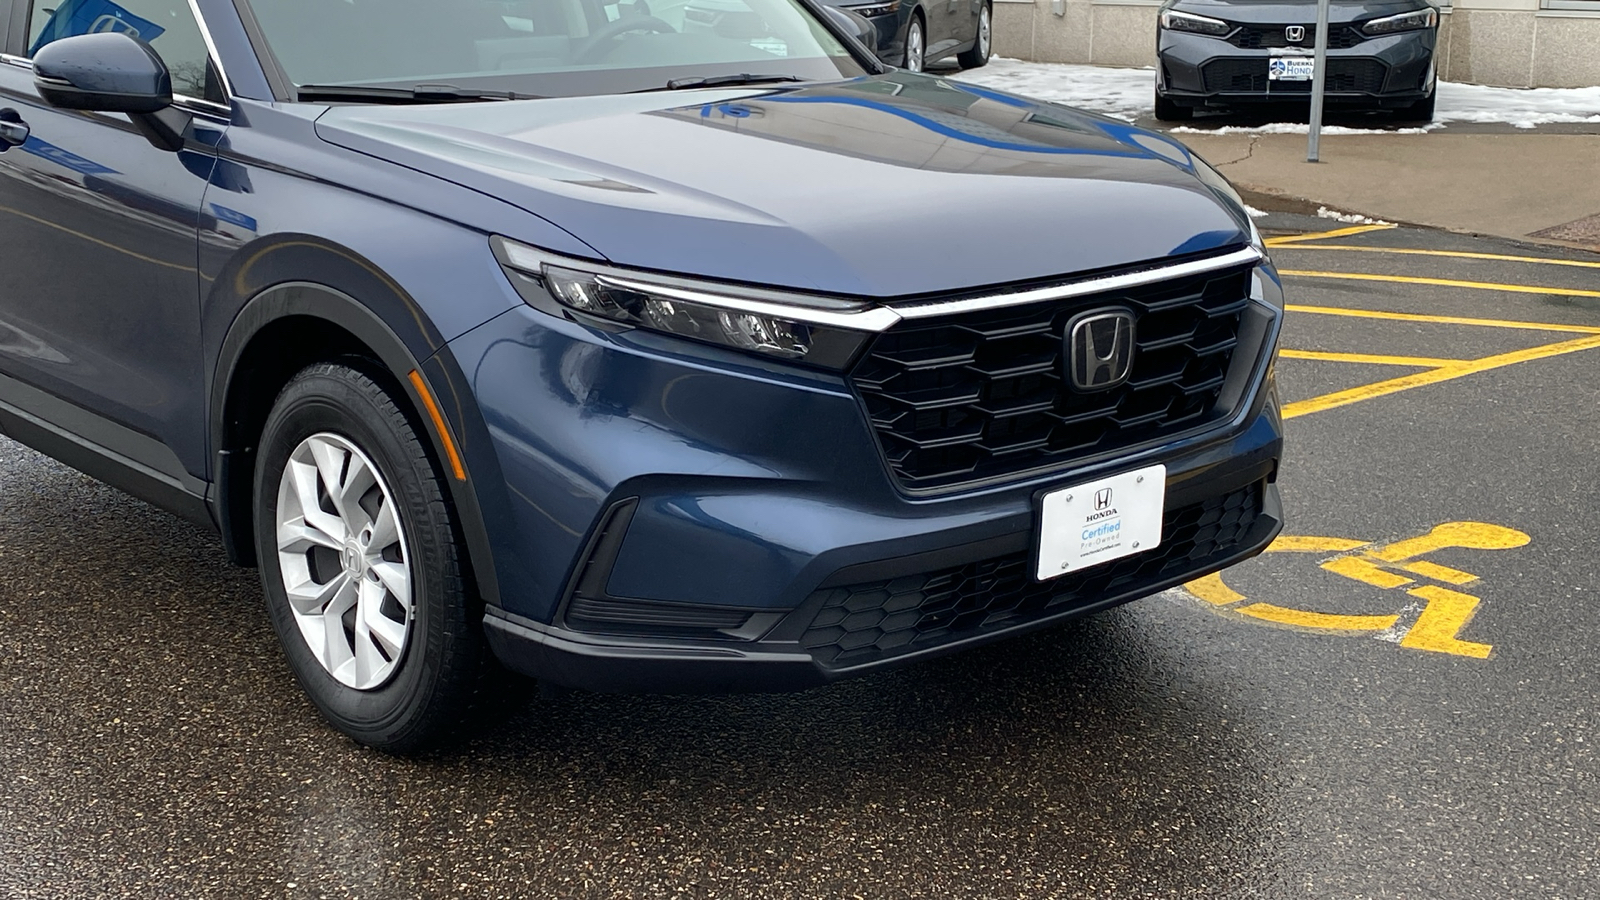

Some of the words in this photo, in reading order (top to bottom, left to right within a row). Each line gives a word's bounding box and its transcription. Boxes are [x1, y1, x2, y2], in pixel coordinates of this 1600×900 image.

[1086, 508, 1117, 522] HONDA
[1082, 519, 1121, 540] Certified
[1081, 532, 1120, 549] Pre-Owned
